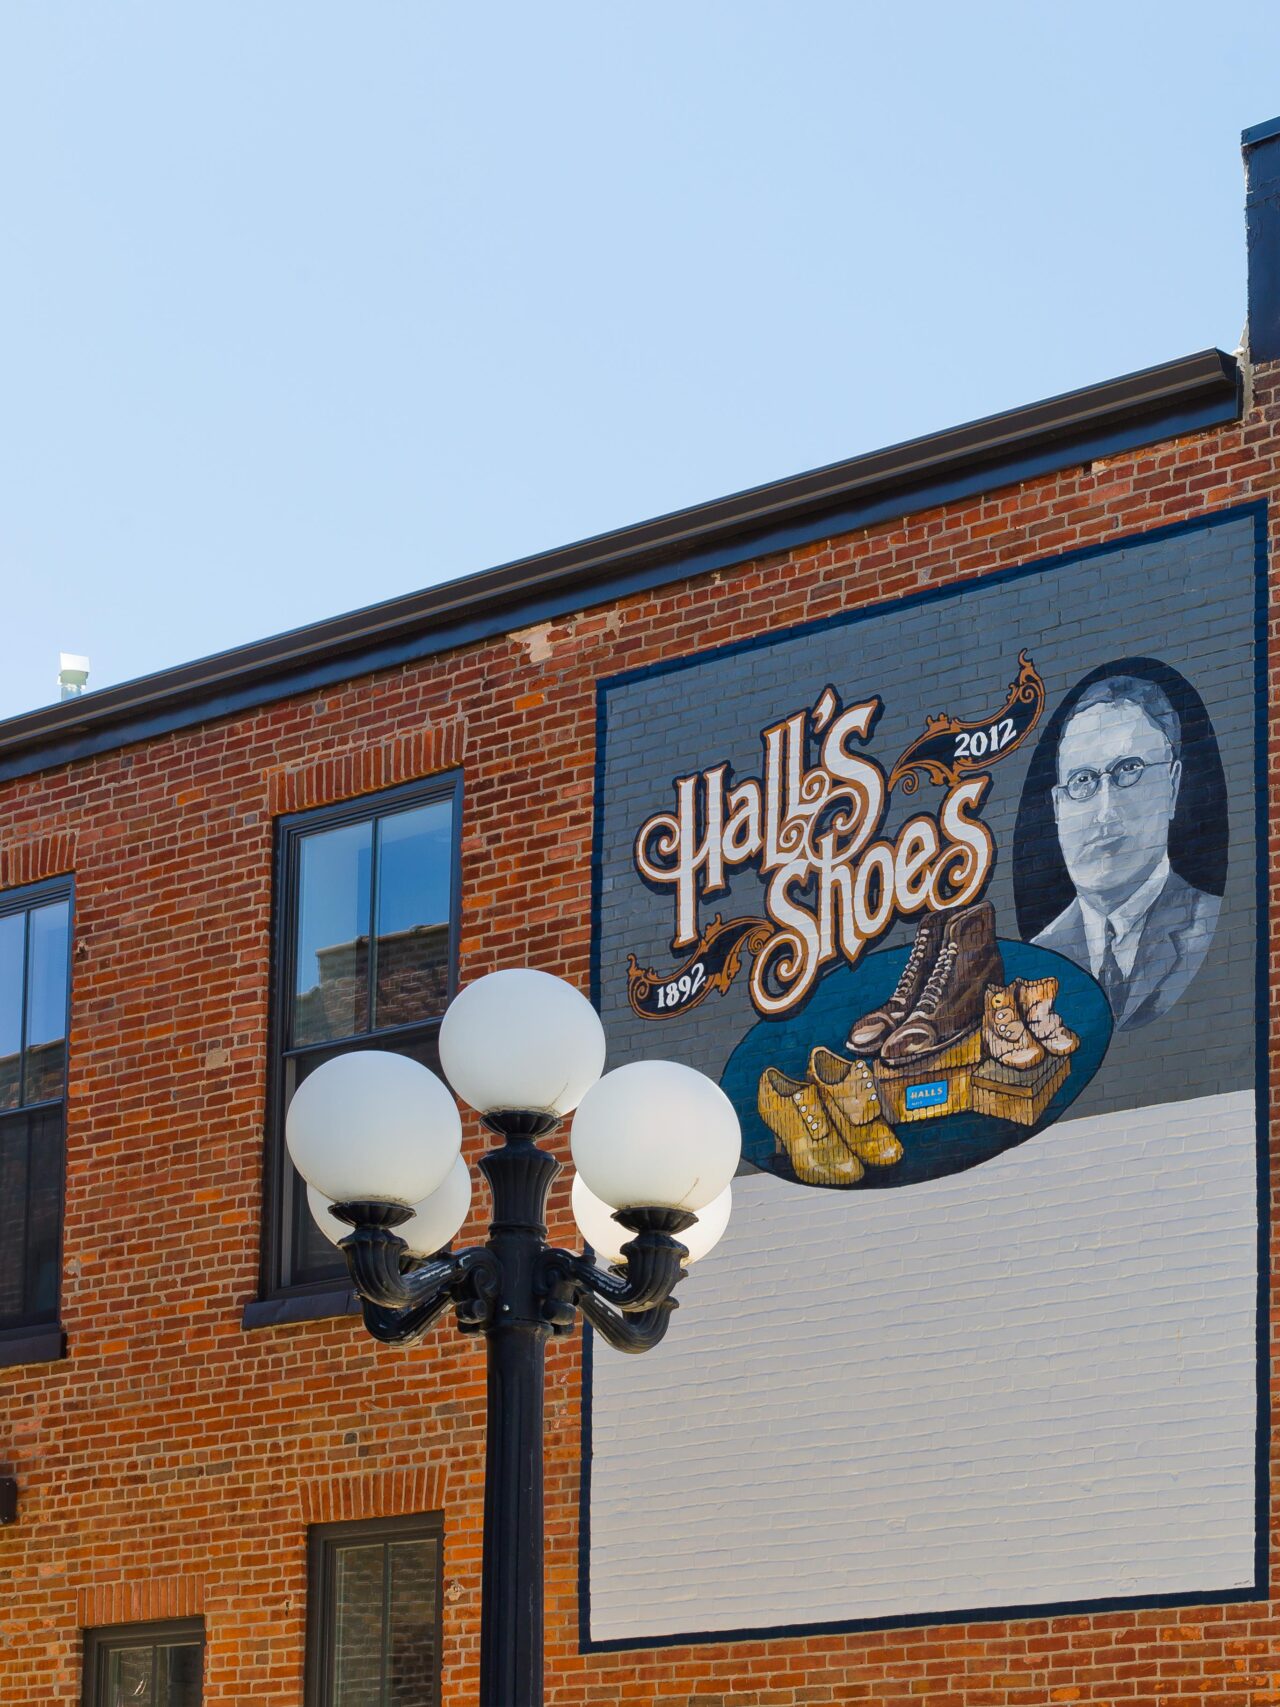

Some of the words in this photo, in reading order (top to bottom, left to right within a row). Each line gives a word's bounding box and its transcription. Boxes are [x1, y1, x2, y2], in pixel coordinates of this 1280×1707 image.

[954, 718, 1017, 757] 2012
[657, 962, 706, 1008] 1892
[911, 1088, 942, 1098] HALLS
